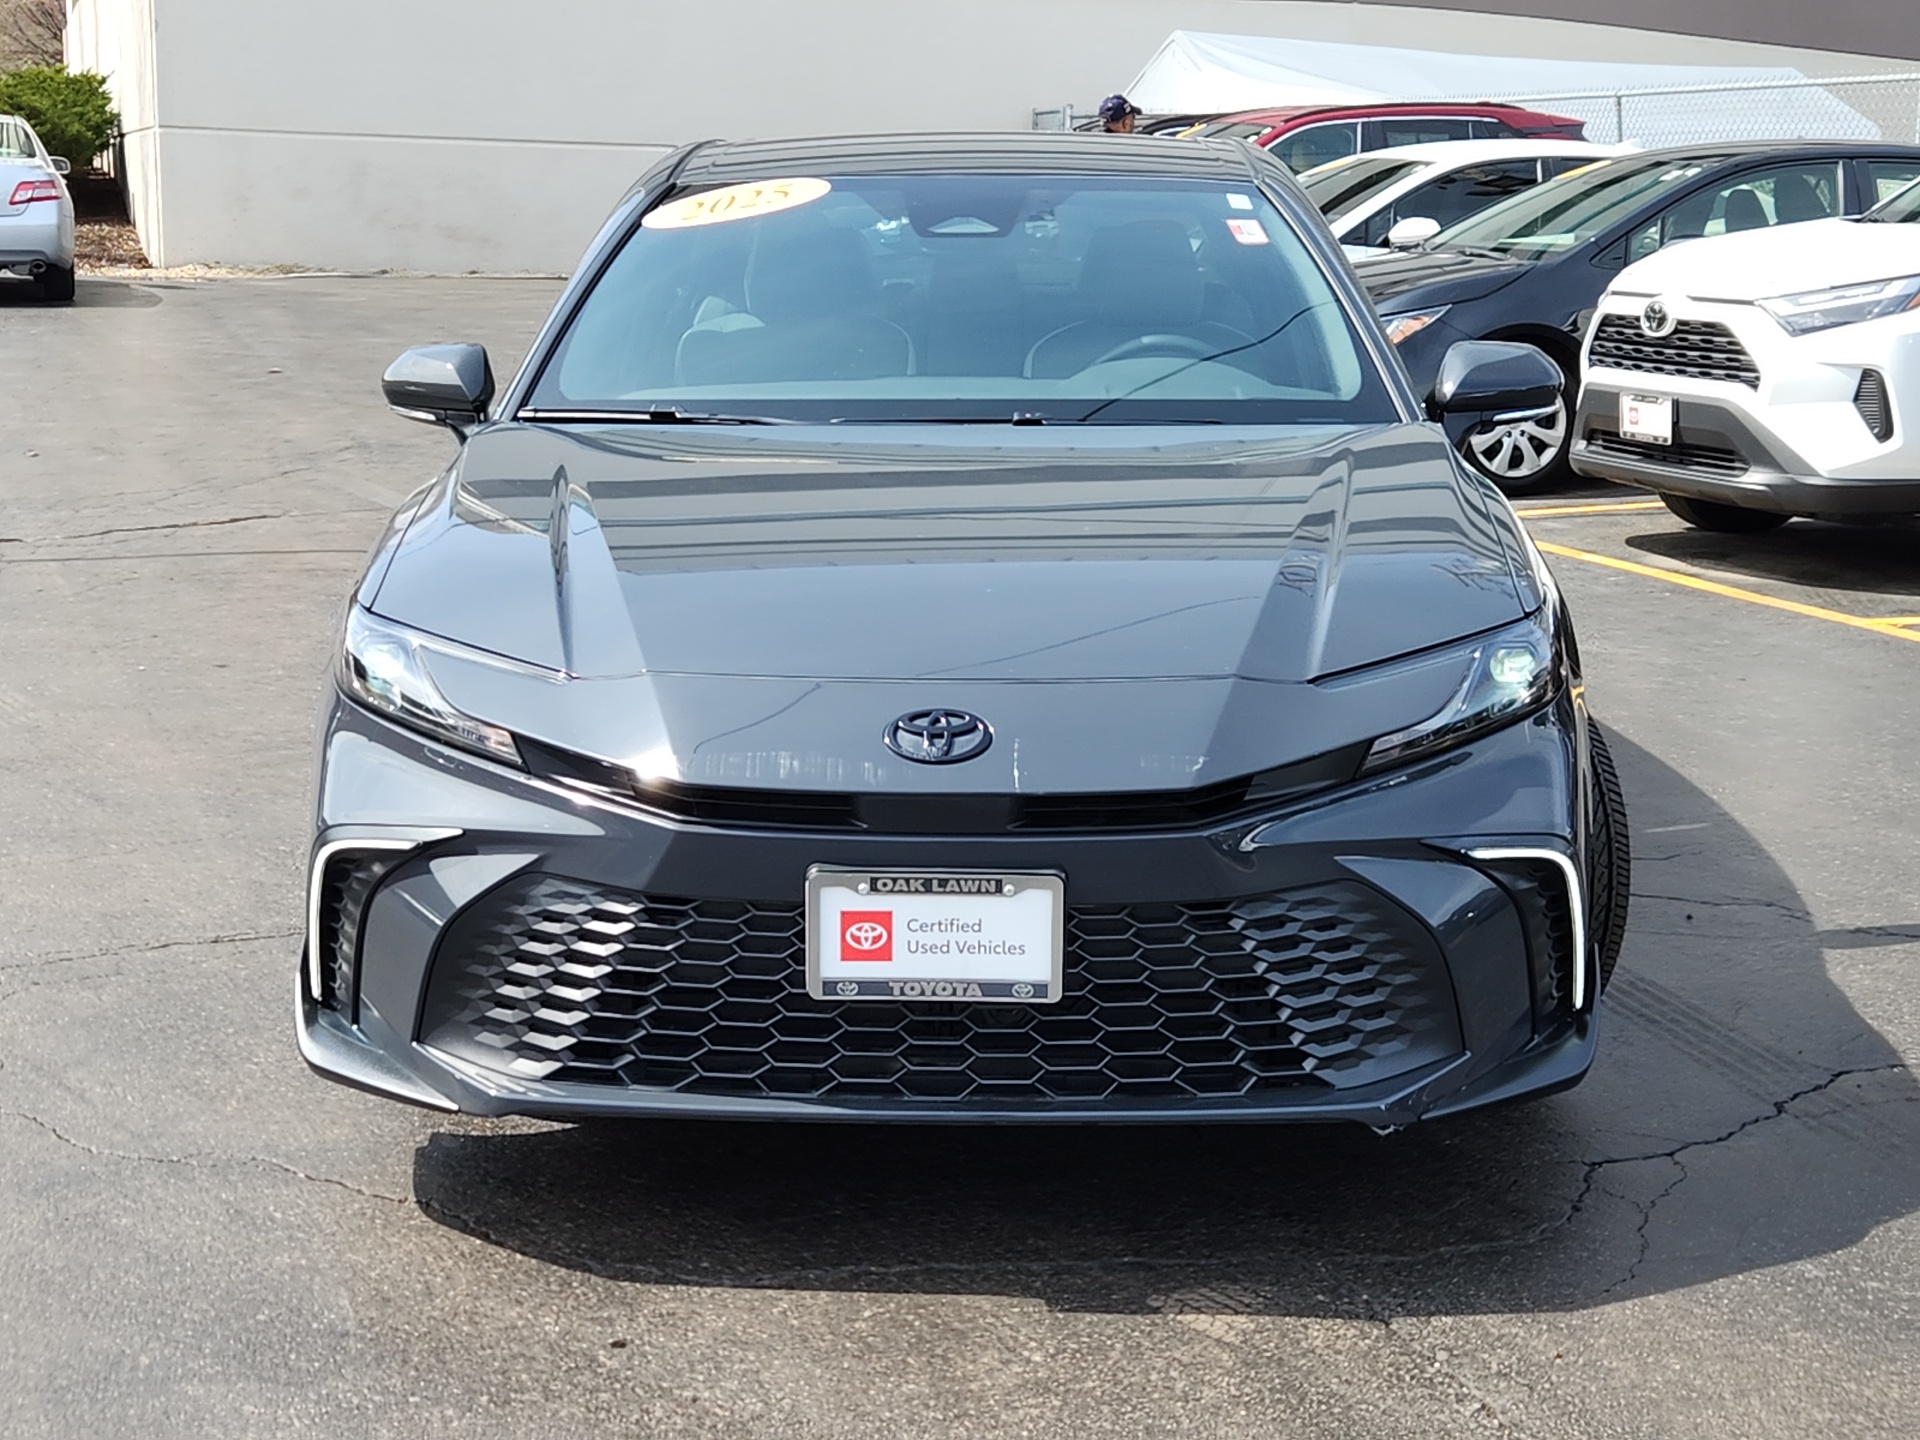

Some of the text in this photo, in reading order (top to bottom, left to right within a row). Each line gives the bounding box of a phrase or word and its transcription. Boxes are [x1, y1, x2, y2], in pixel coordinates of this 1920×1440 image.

[681, 181, 794, 221] 2025
[876, 878, 997, 893] OAK LAWN
[906, 918, 982, 933] Certified
[906, 940, 1026, 955] Used Vehicles
[889, 981, 983, 997] TOYOTA
